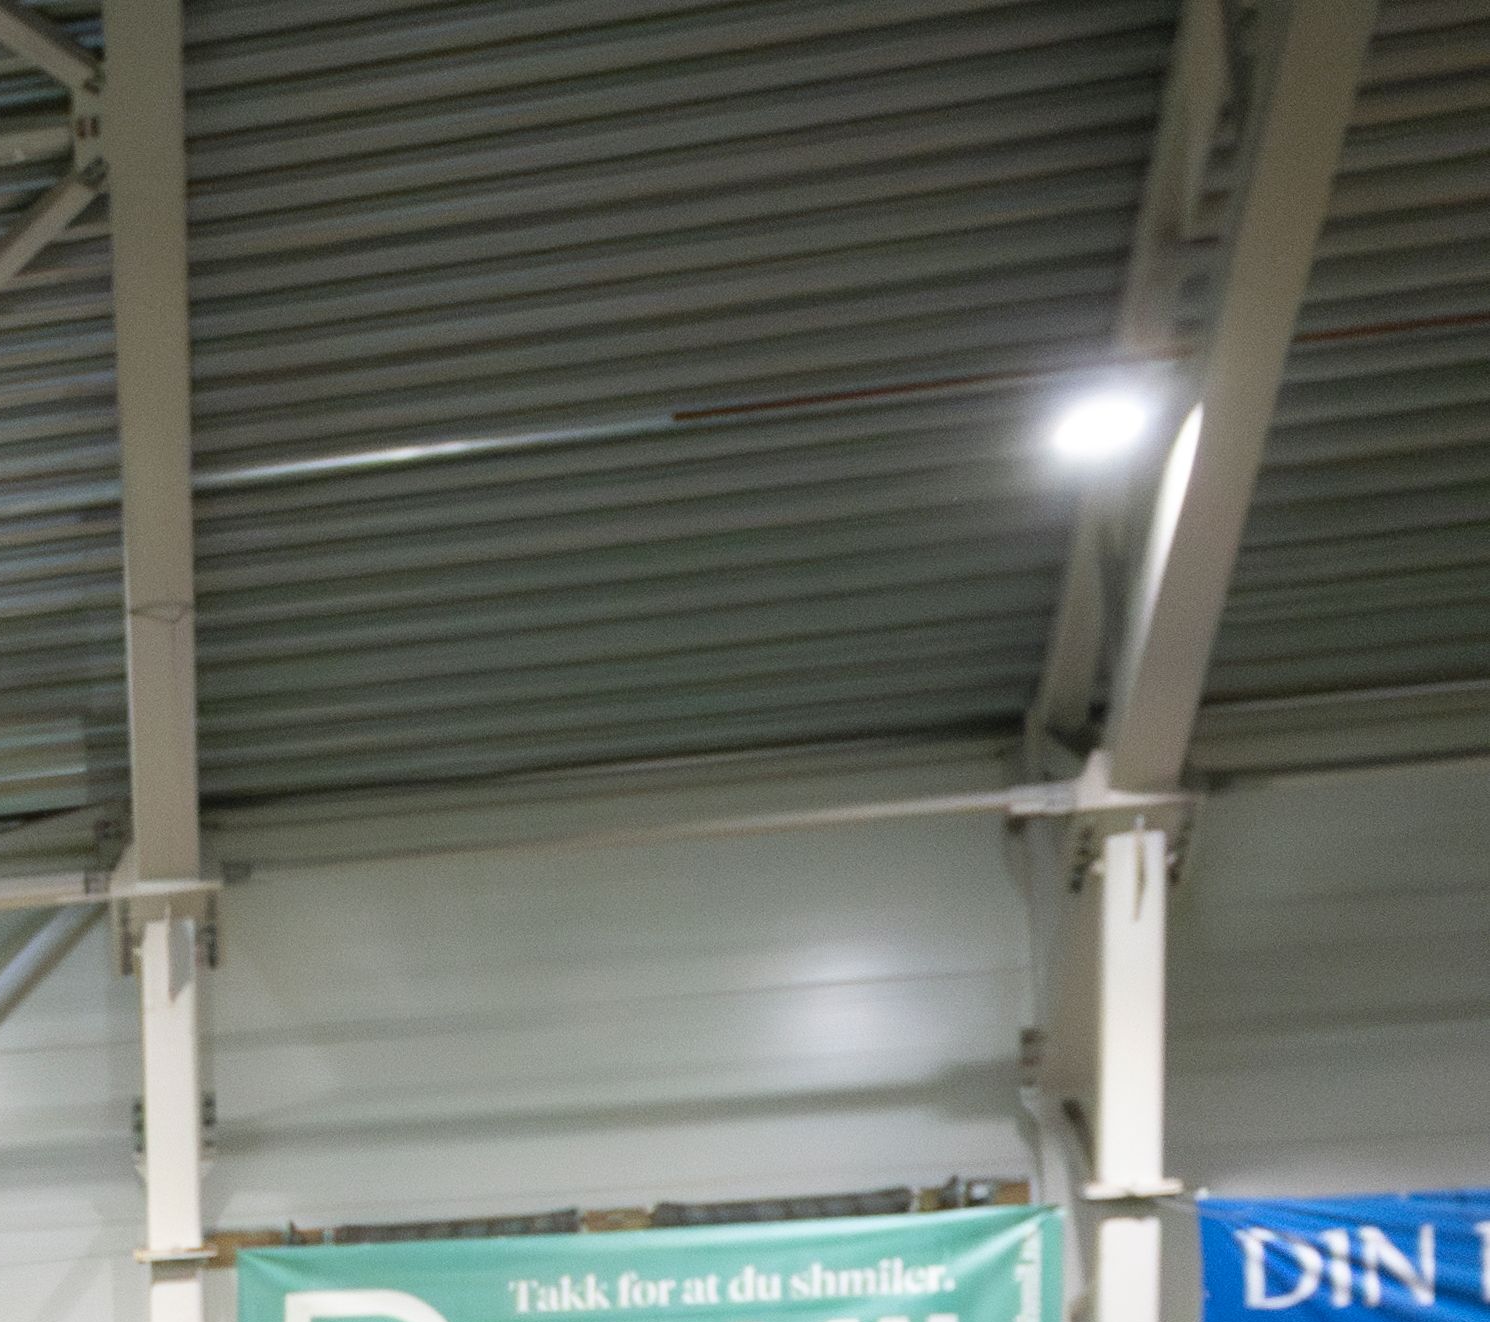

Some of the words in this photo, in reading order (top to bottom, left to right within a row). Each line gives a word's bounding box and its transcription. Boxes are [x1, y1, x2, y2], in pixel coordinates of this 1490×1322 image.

[508, 1273, 610, 1313] Takk
[617, 1270, 674, 1308] for
[681, 1272, 720, 1305] at
[732, 1264, 783, 1302] du
[788, 1257, 956, 1302] shmiler.
[1234, 1223, 1435, 1310] DIN
